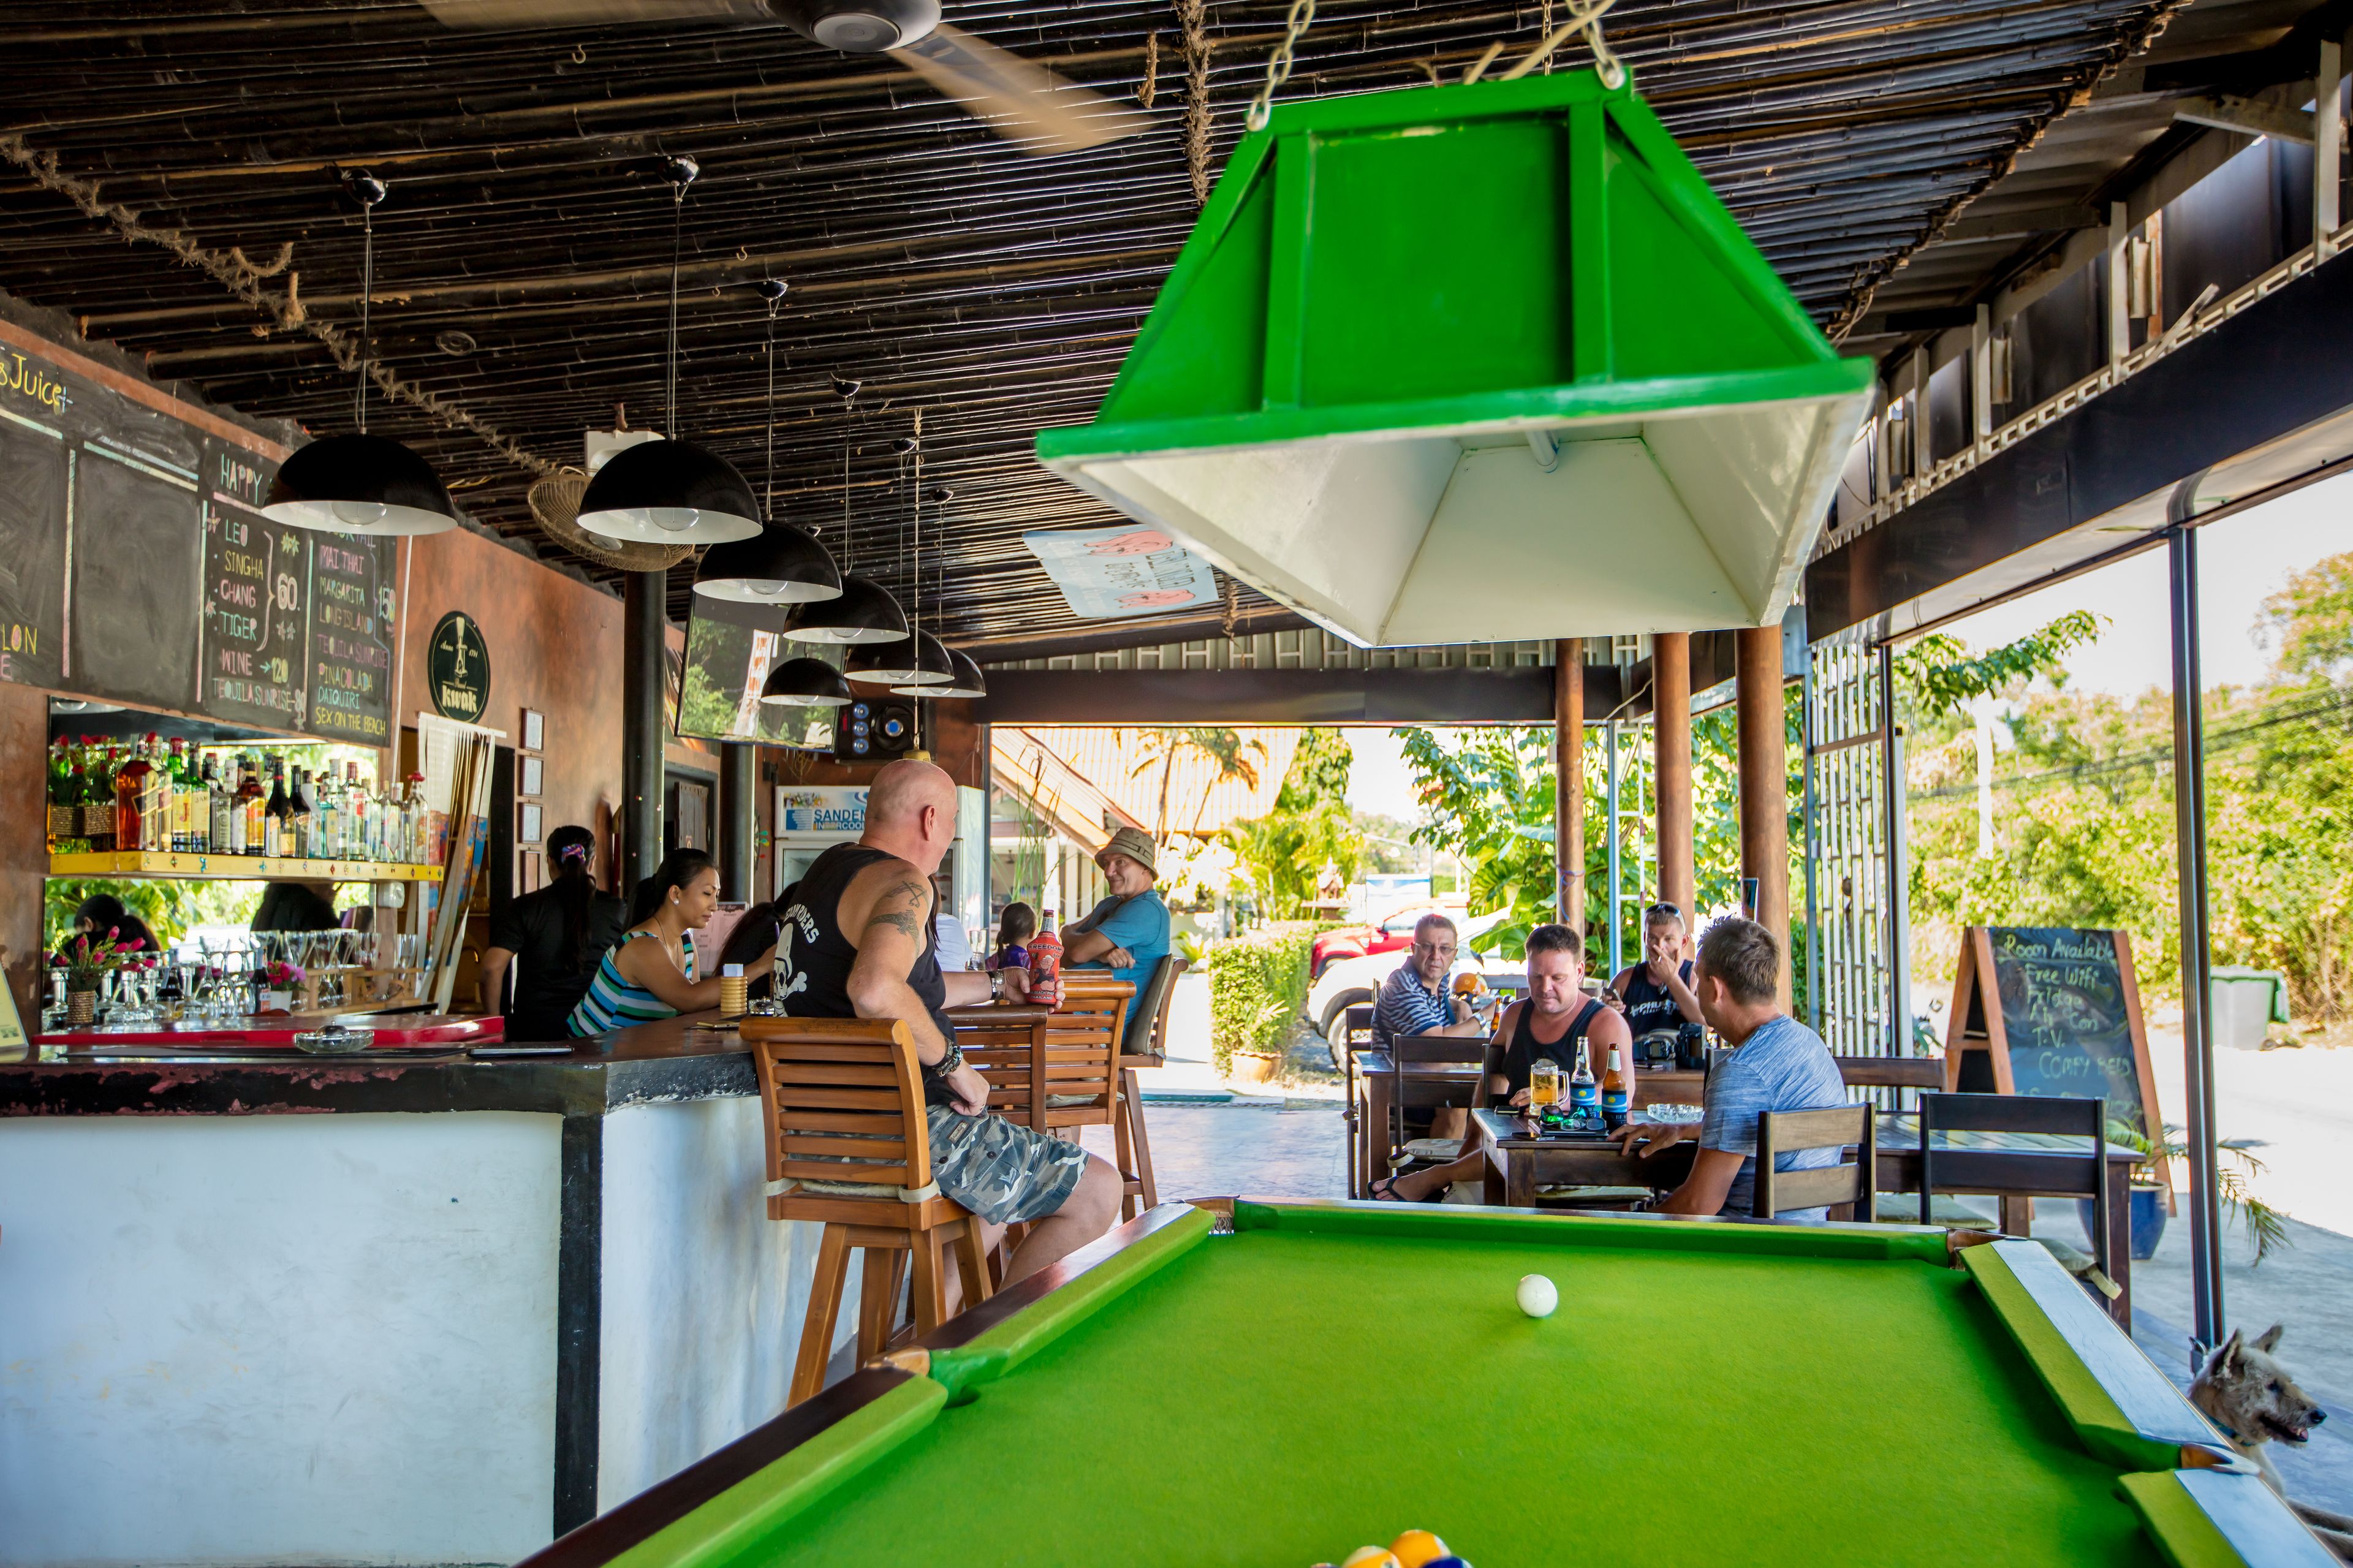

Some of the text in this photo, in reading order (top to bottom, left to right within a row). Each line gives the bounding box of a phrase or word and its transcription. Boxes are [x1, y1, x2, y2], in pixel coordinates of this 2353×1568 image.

[9, 354, 62, 406] Juice
[221, 453, 263, 505] HAPPY
[225, 519, 248, 547] LEO
[225, 550, 263, 581] SINGHA
[320, 545, 365, 575] MAI THAI
[220, 579, 256, 608] CHANG
[320, 575, 365, 607] MARGARITA
[220, 610, 257, 642] TIGER
[319, 602, 342, 626] LONG
[343, 607, 373, 635] ISLAND
[221, 648, 289, 684] WINE 120
[317, 634, 388, 669] TEQUILA SUNRISE
[213, 677, 254, 704] TEQUILA
[318, 686, 360, 710] DAIQUIRI
[316, 706, 387, 737] SEX ON THE BEACH
[1029, 944, 1063, 953] FREEDOM
[2004, 934, 2048, 959] Room
[2025, 962, 2101, 991] Free Wifi
[2039, 1051, 2090, 1079] COMFY
